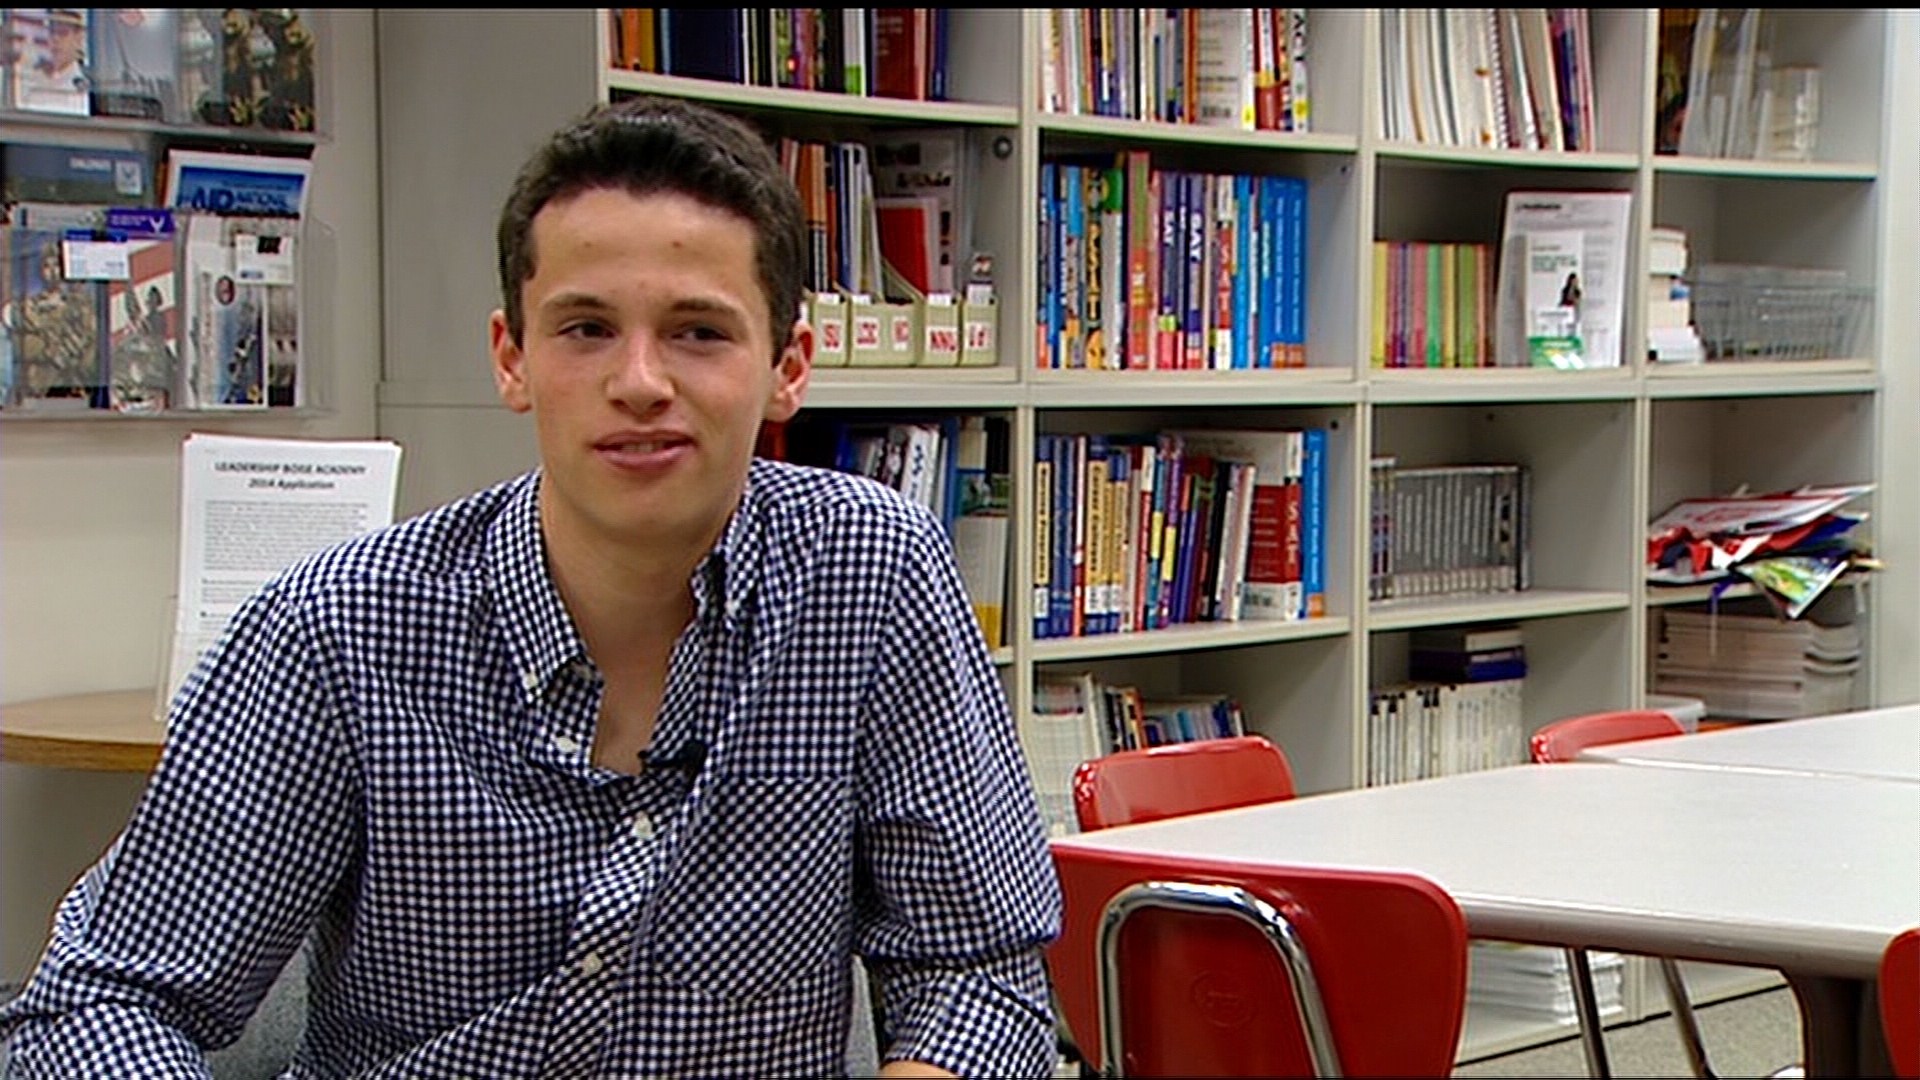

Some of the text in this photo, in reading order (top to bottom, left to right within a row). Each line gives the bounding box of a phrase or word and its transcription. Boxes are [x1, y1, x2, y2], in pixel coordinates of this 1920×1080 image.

[1163, 209, 1174, 247] SAT
[1190, 211, 1203, 262] SAT
[1220, 243, 1232, 312] SAT
[214, 461, 366, 476] LEADERSHIP BOISE ACADEMY
[248, 478, 335, 491] 2014 Application
[1090, 465, 1101, 573] Career Colleges
[1287, 500, 1299, 564] SAT
[1039, 519, 1048, 579] Programs
